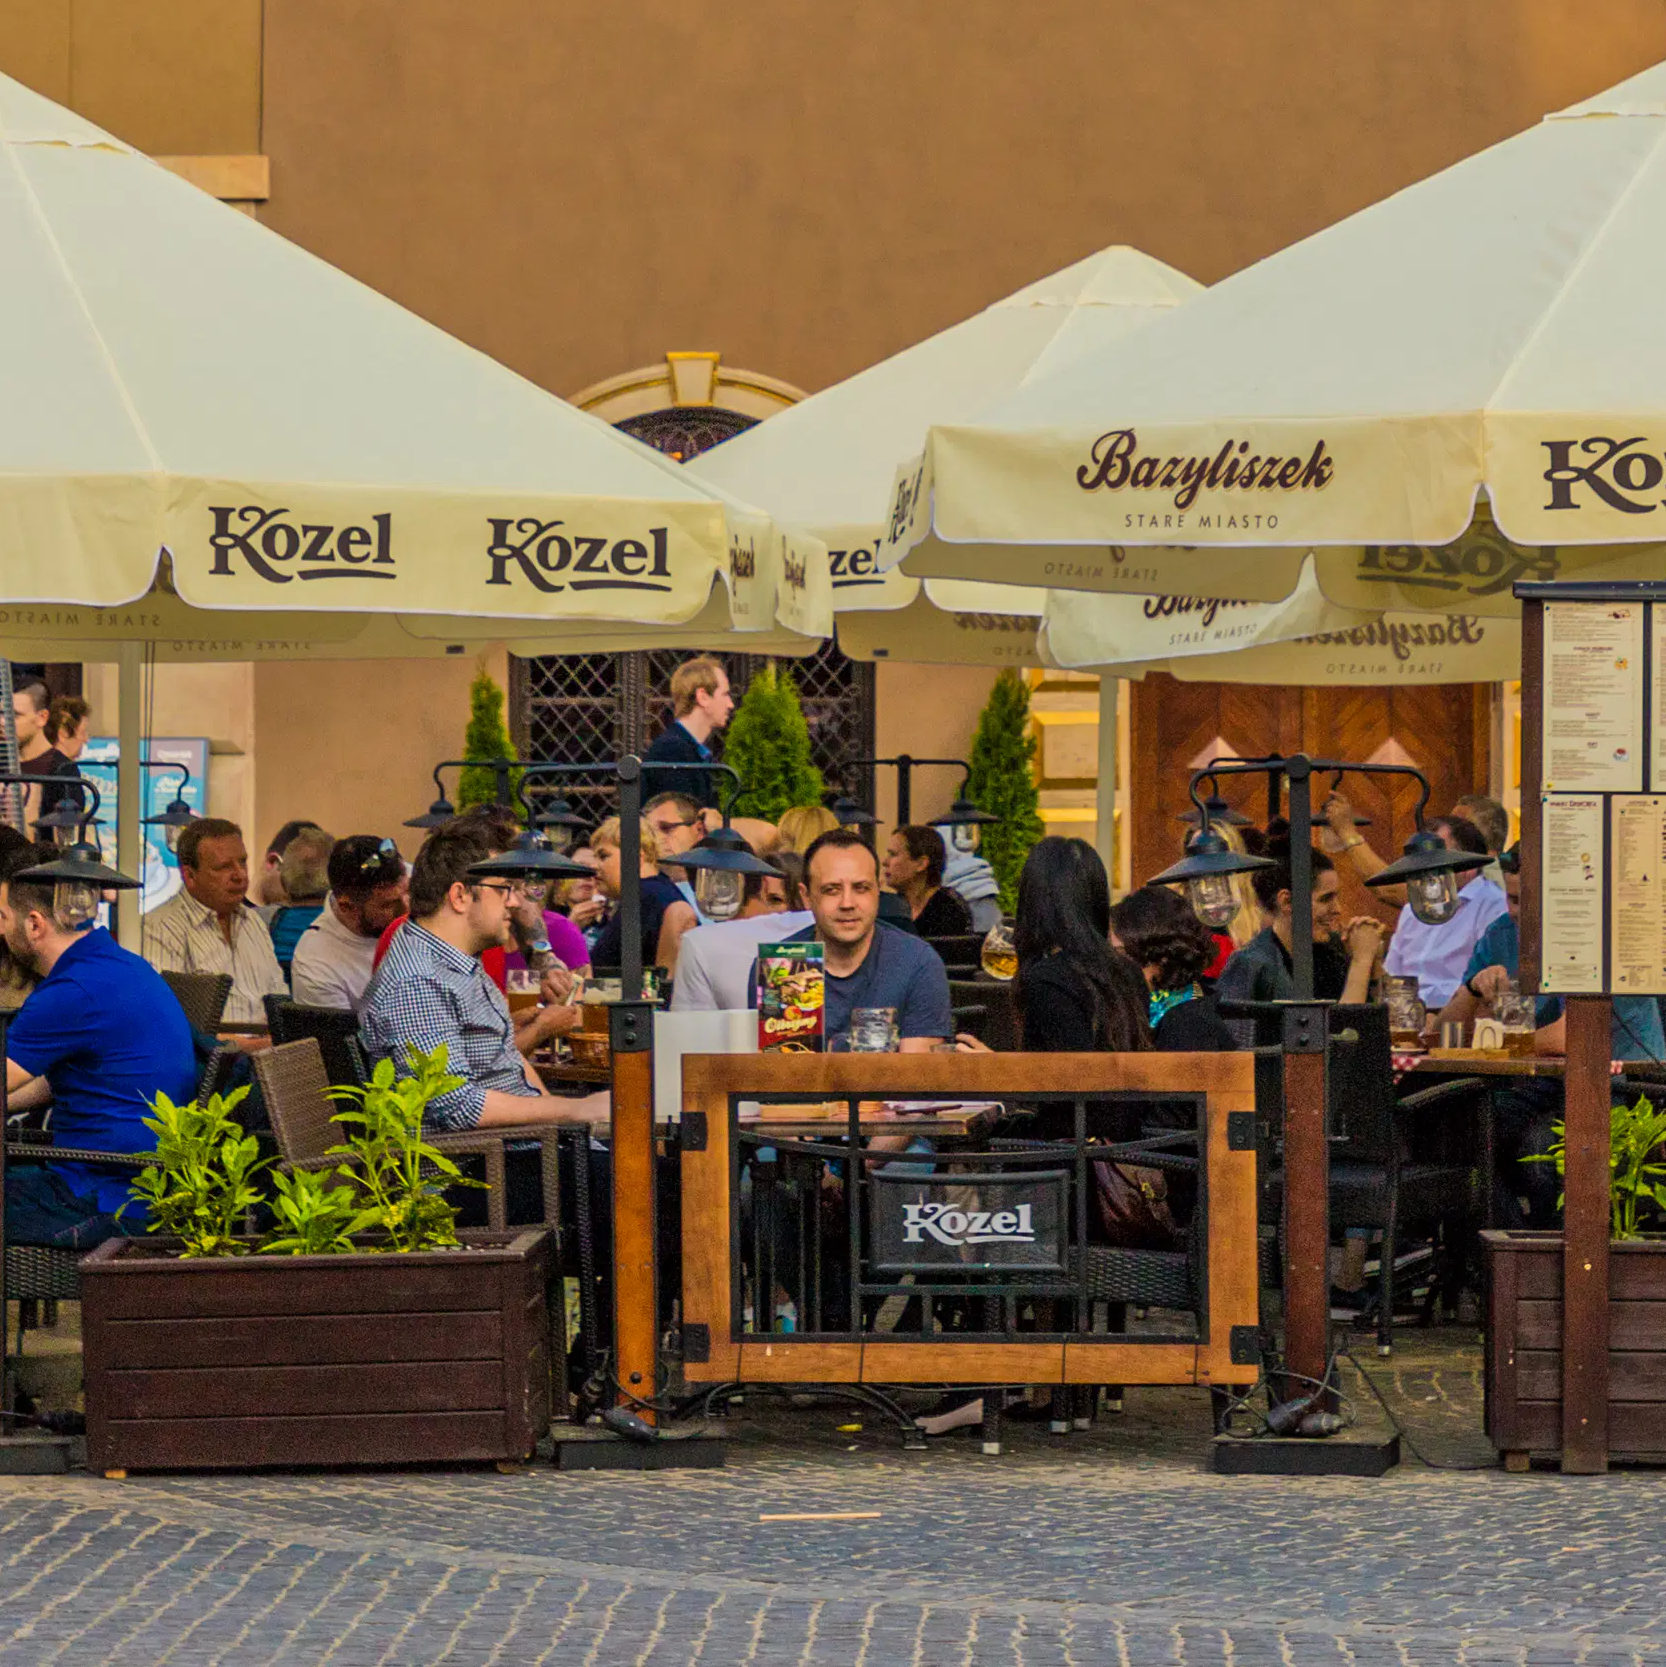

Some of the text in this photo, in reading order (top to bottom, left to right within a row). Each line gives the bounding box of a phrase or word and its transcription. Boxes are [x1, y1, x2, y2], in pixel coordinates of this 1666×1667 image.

[1076, 428, 1335, 512] Bazyliszek
[209, 505, 397, 583] Kozel
[485, 517, 672, 594] Kozel
[1125, 513, 1280, 529] STARE MIASTO
[902, 1202, 1035, 1247] Kozel
